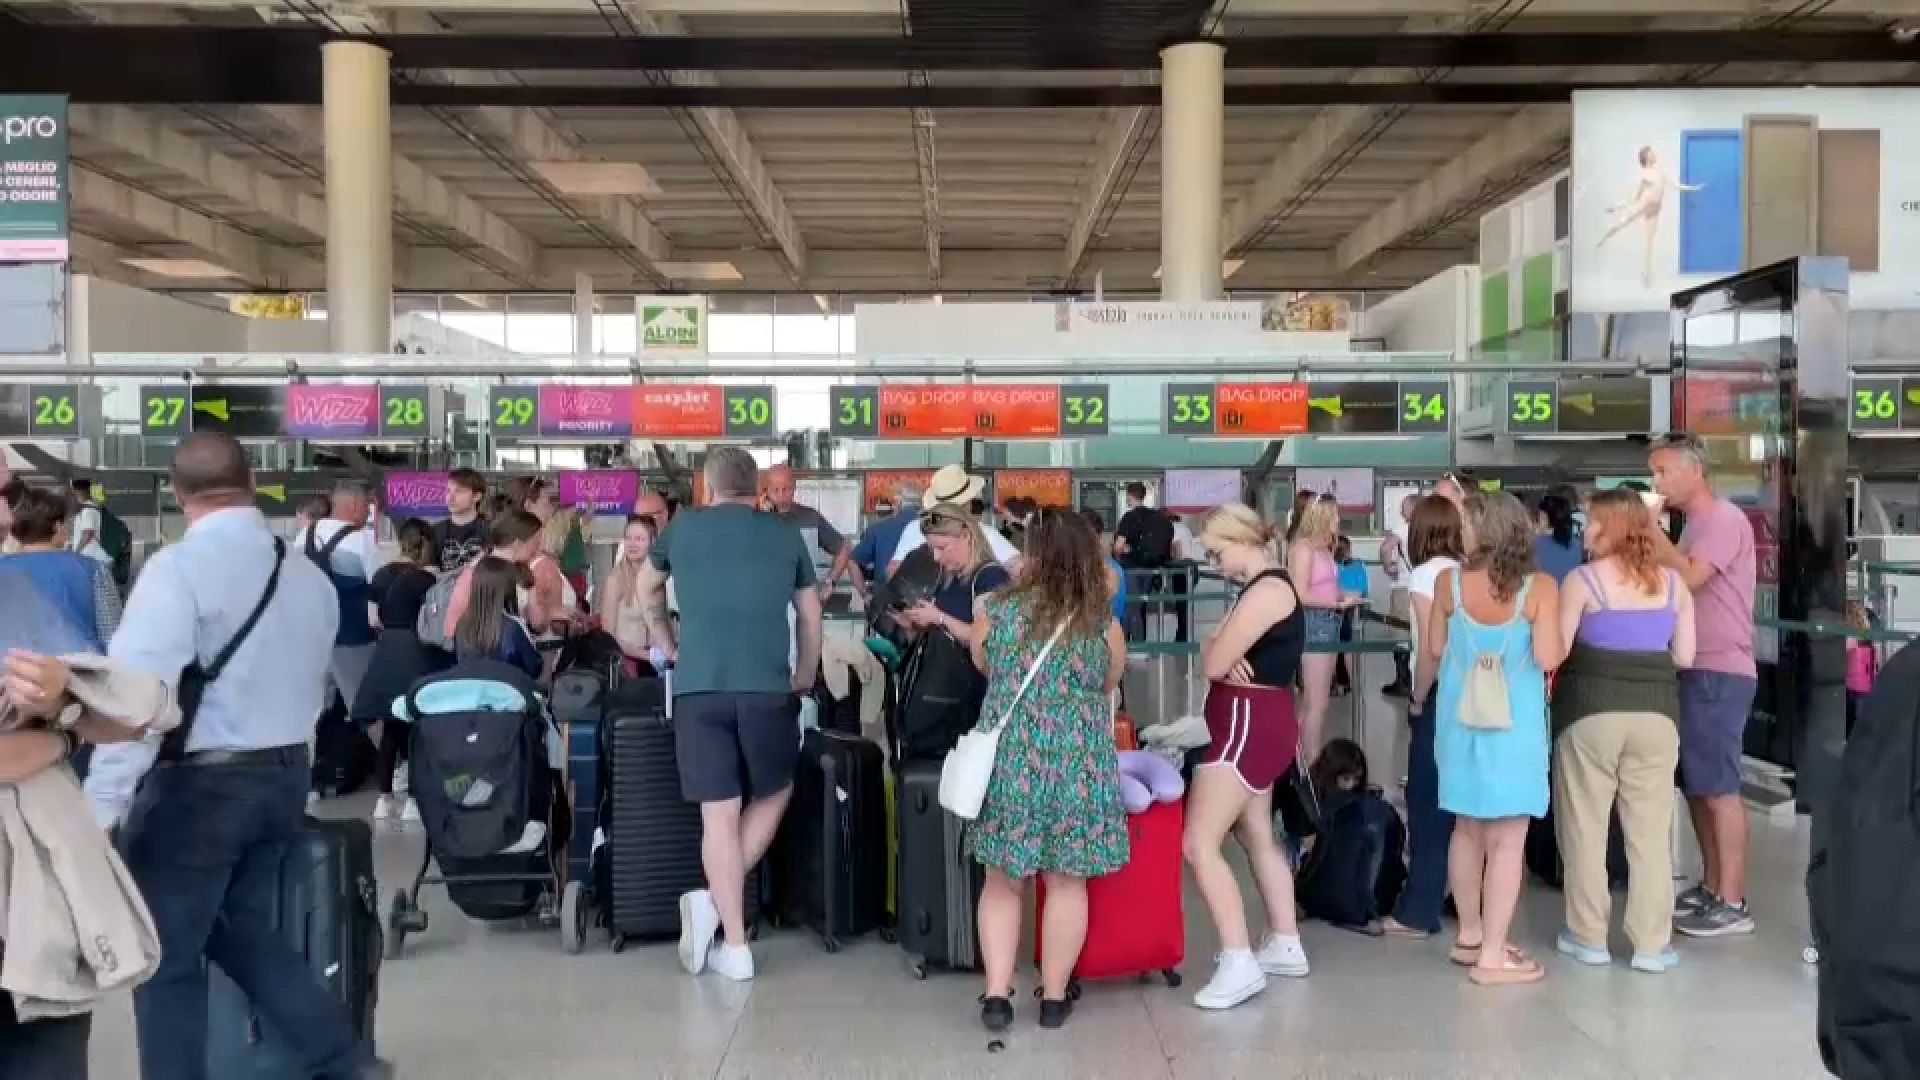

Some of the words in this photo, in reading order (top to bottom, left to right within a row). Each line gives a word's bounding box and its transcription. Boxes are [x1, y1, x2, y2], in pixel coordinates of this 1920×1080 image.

[5, 116, 57, 145] pro
[5, 162, 57, 173] MEGLIO
[645, 326, 699, 340] ALDINI
[882, 391, 917, 404] BAG
[922, 391, 967, 404] DROP
[973, 391, 1007, 404] BAG
[1010, 391, 1055, 404] DROP
[1172, 394, 1211, 423] 33
[1220, 388, 1255, 402] BAG
[1259, 388, 1305, 402] DROP
[1403, 394, 1445, 422] 34
[1512, 393, 1552, 422] 35
[1856, 390, 1896, 418] 36
[36, 398, 75, 426] 26
[148, 397, 186, 427] 27
[386, 397, 425, 426] 28
[496, 399, 535, 427] 29
[730, 397, 770, 426] 30
[839, 397, 872, 425] 31
[1064, 396, 1104, 425] 32
[558, 421, 615, 432] PRIORITY
